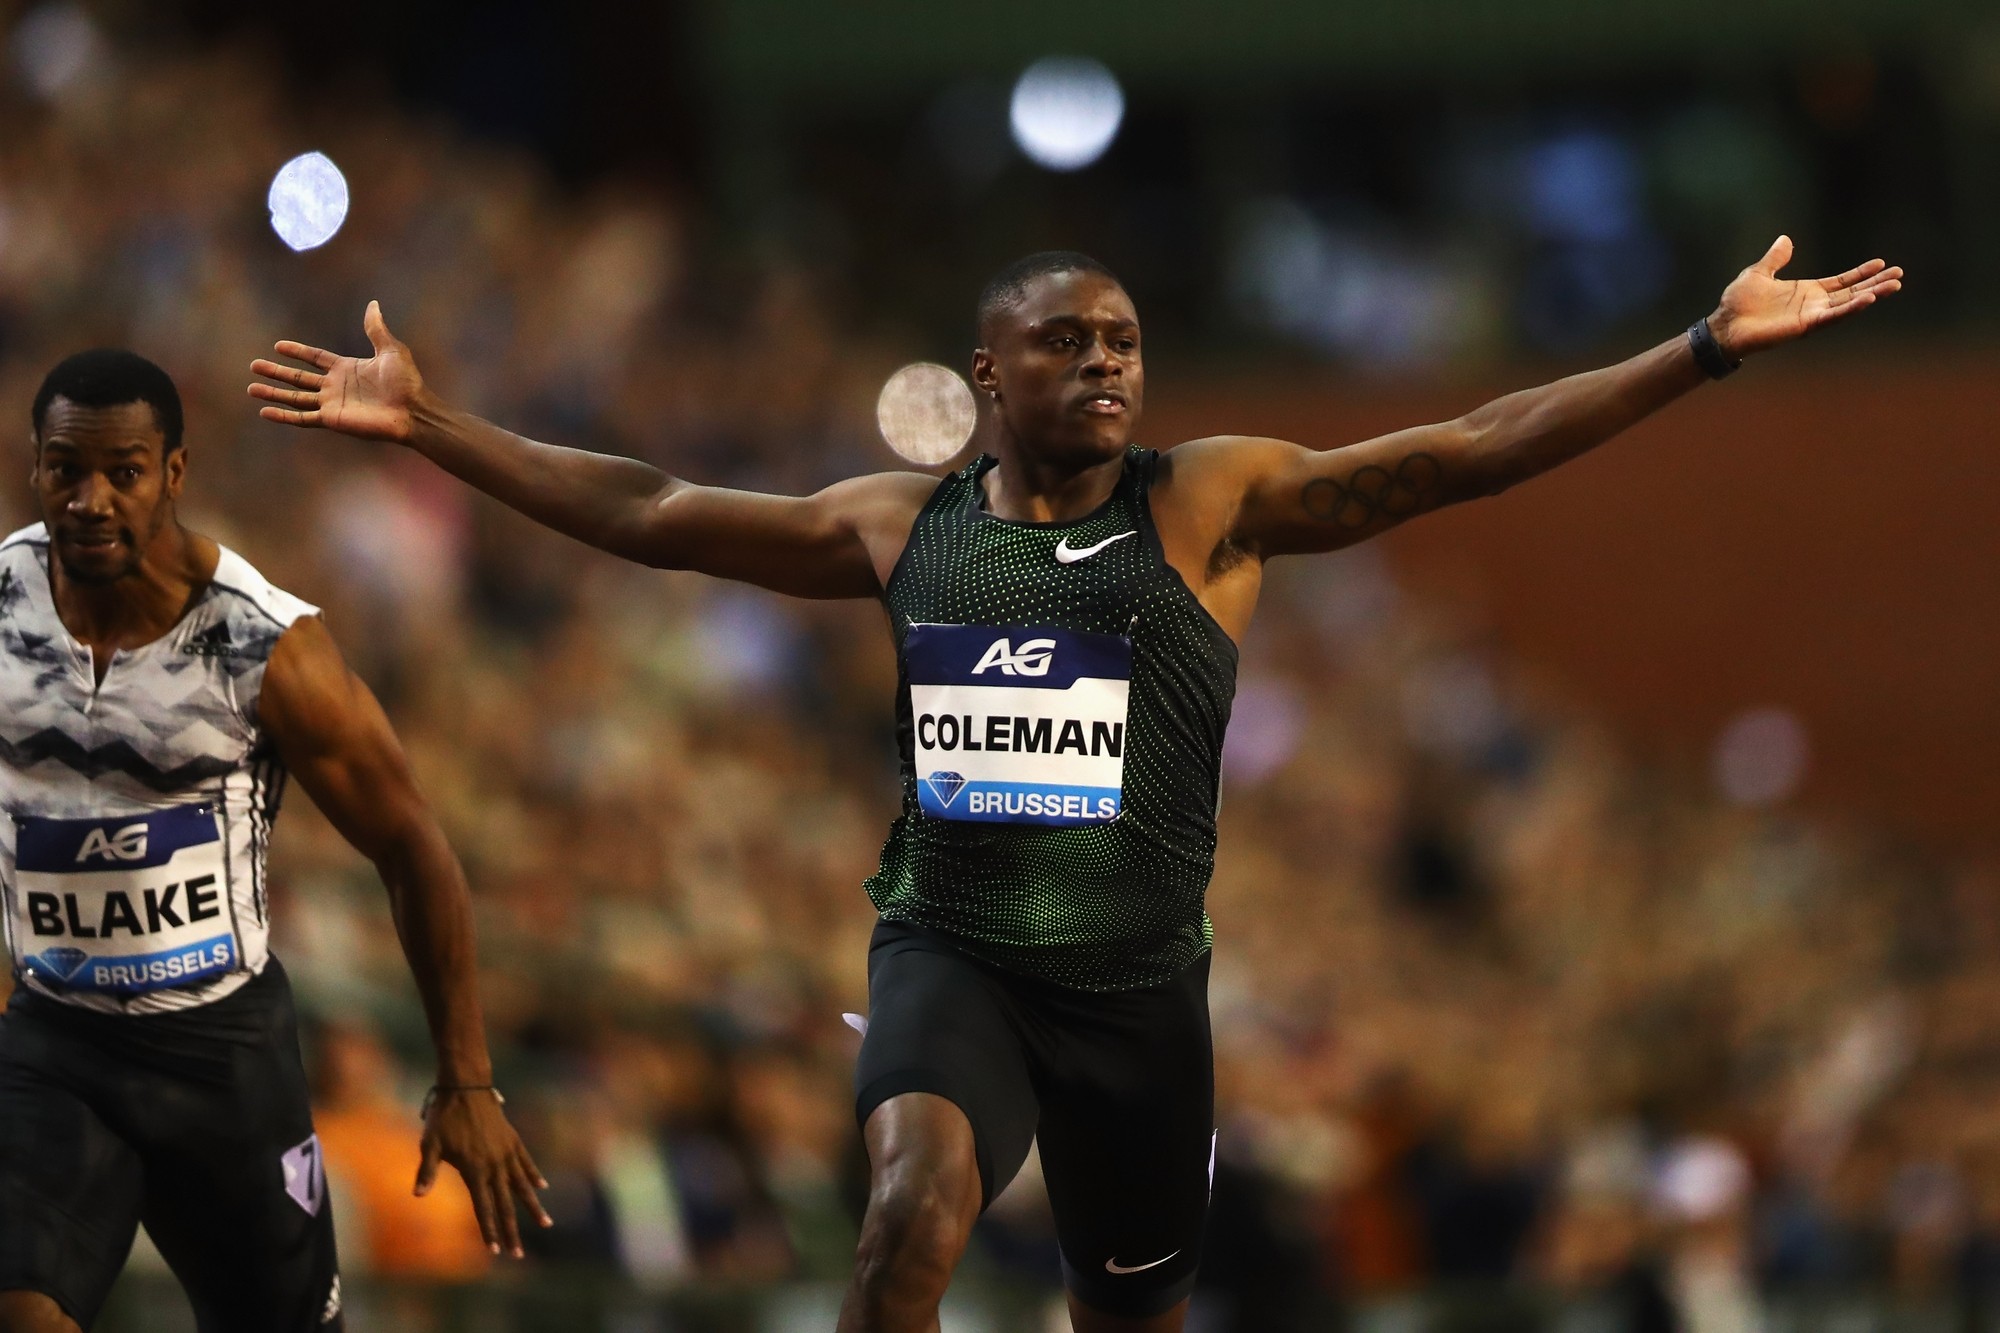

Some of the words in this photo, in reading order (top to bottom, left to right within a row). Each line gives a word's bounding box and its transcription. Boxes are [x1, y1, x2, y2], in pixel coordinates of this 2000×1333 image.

[971, 637, 1057, 677] AG
[918, 713, 1123, 758] COLEMAN
[969, 791, 1116, 819] BRUSSELS
[75, 822, 149, 863] AG
[27, 873, 220, 938] BLAKE
[93, 943, 230, 986] BRUSSELS
[301, 1142, 315, 1201] 7
